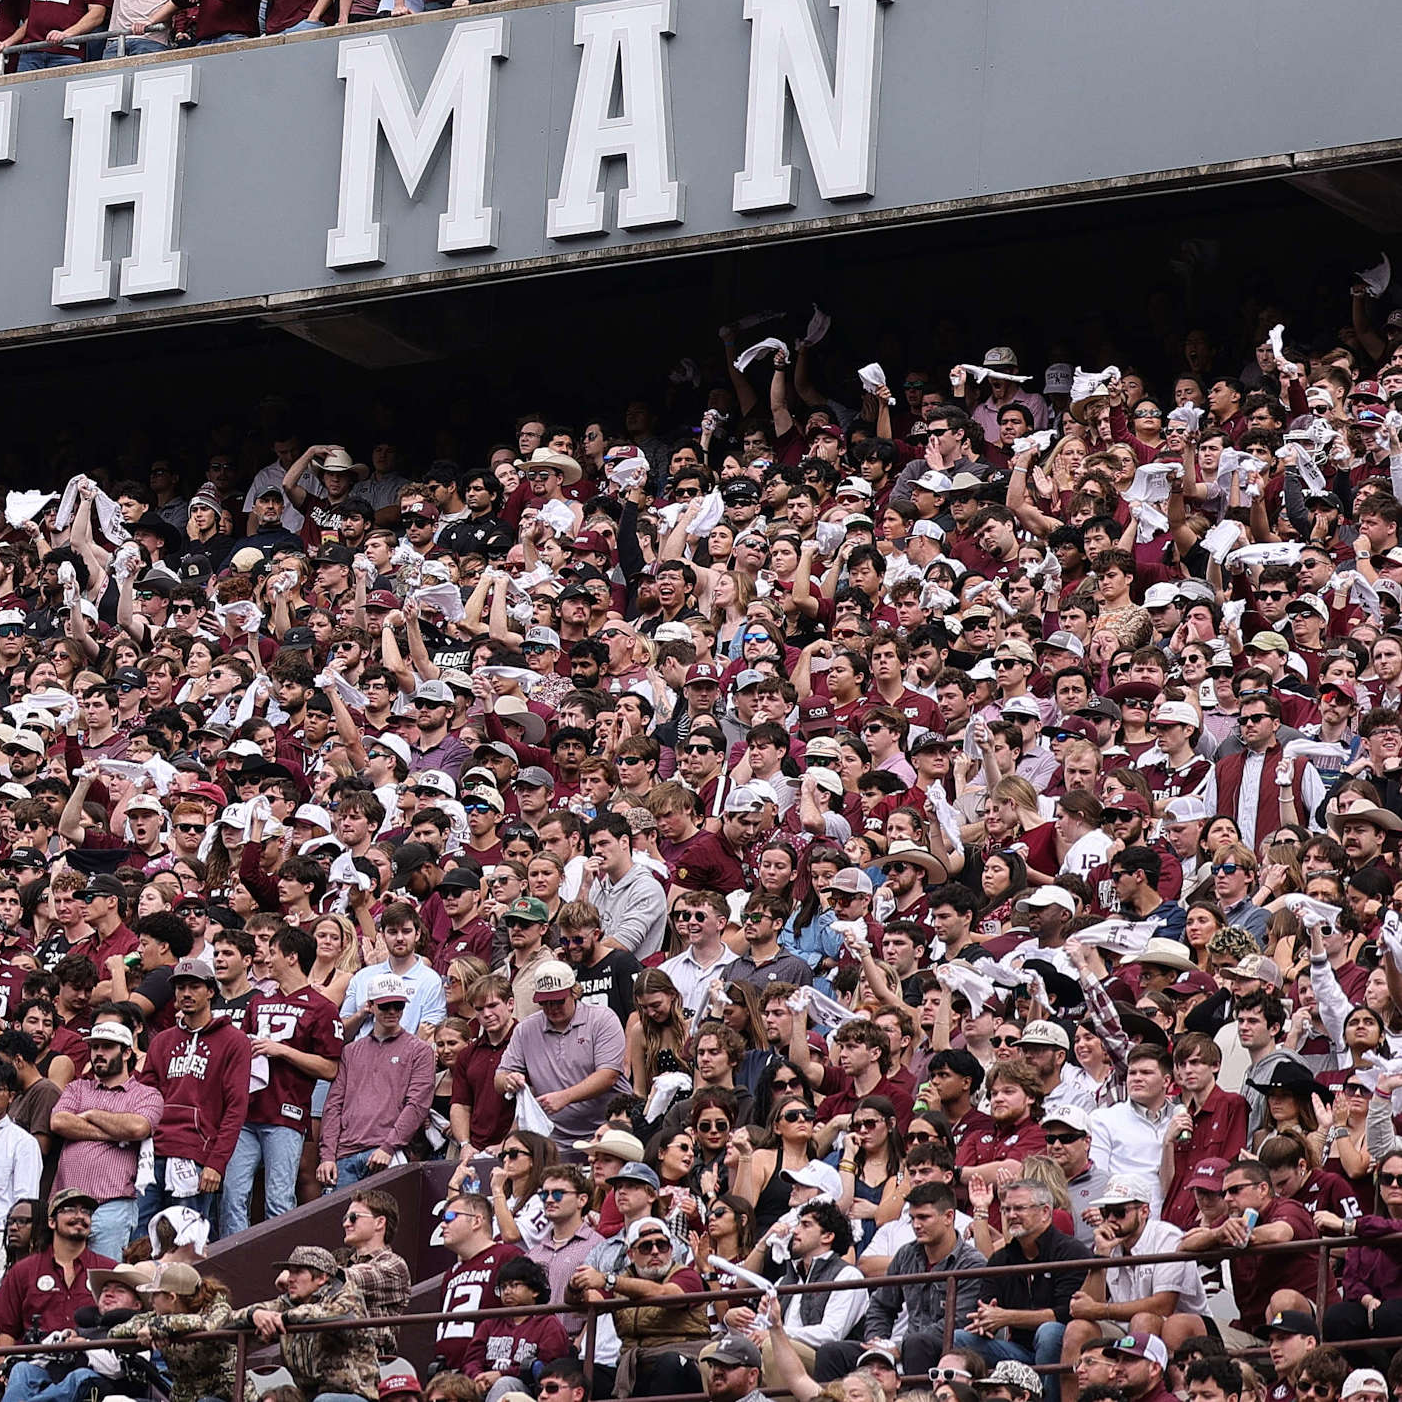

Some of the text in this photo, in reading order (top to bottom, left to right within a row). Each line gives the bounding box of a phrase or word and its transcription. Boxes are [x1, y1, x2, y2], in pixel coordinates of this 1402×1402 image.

[808, 707, 828, 716] COX
[225, 807, 238, 816] TX
[1081, 854, 1100, 869] 12
[258, 1004, 304, 1018] TEXAS A&M
[256, 1012, 298, 1042] 12
[332, 1020, 344, 1040] 12
[1197, 1167, 1215, 1176] Howdy
[1340, 1196, 1362, 1217] 12
[719, 1336, 732, 1350] T
